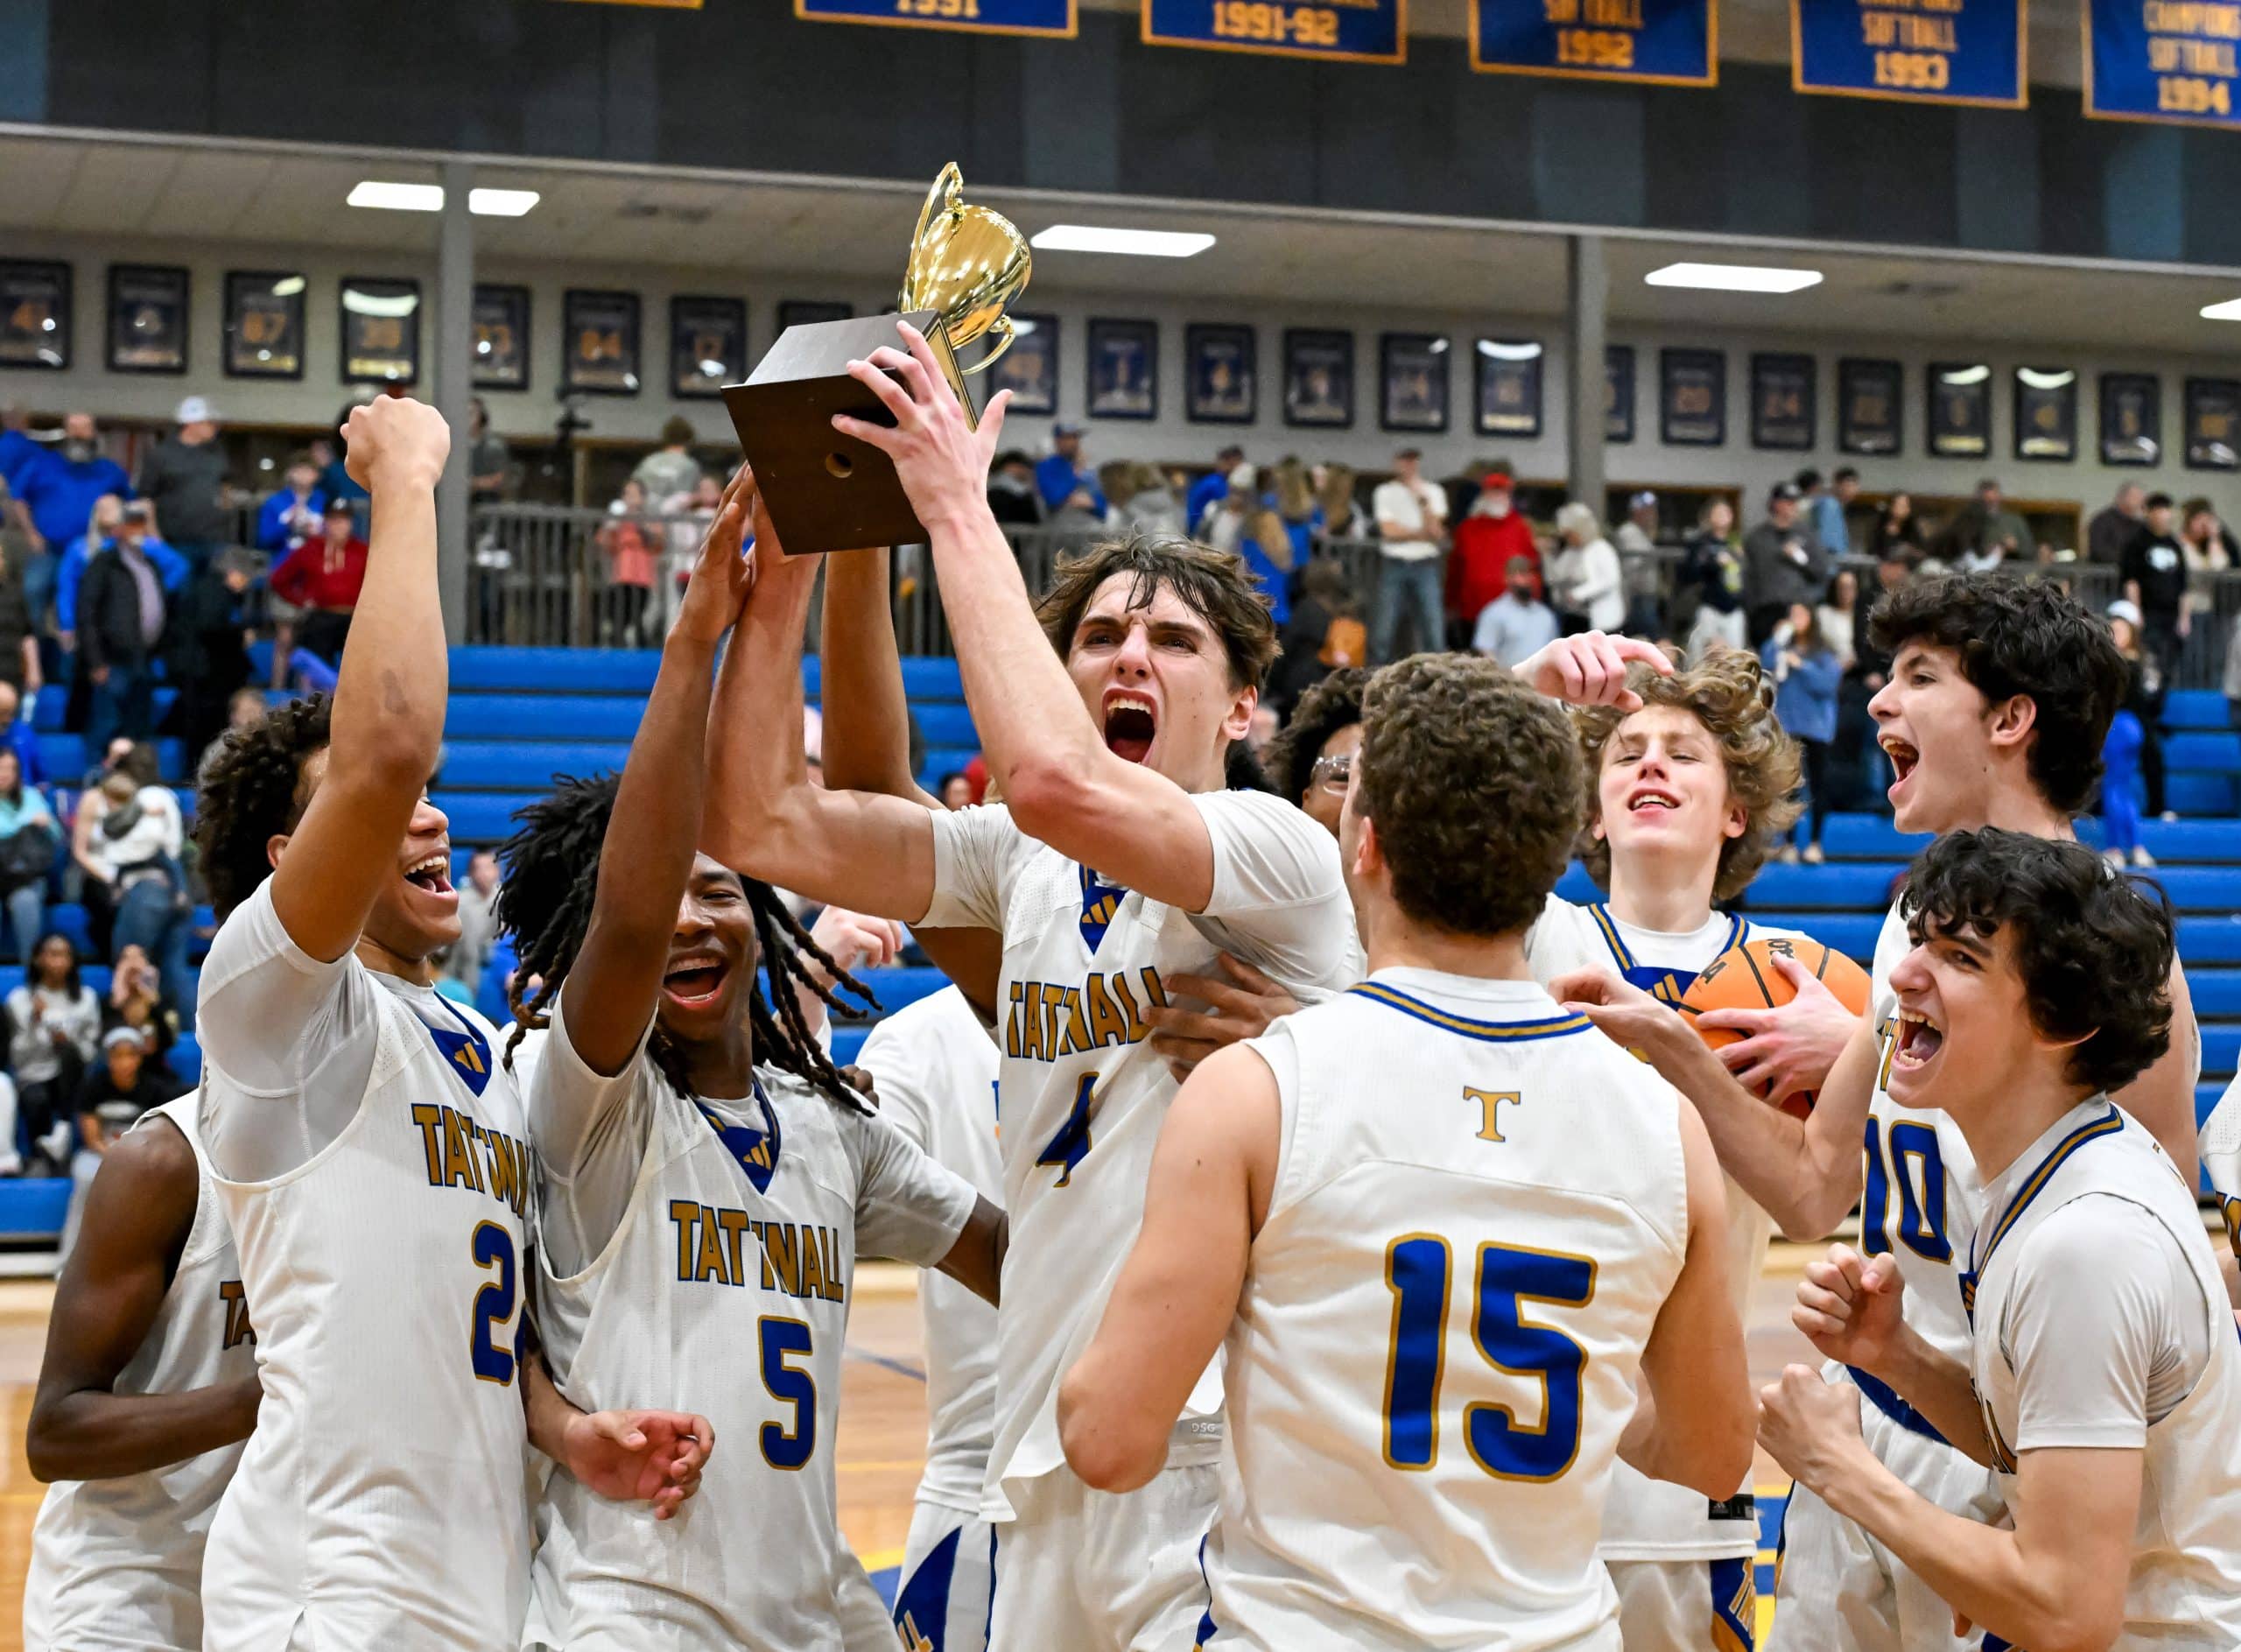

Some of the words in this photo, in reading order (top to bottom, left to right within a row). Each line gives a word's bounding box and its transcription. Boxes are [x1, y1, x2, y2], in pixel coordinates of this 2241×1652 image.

[1213, 1, 1338, 46] 1991-92
[1557, 30, 1633, 68] 1992
[1463, 1086, 1521, 1142] T
[1382, 1231, 1598, 1484] 15
[758, 1314, 816, 1472] 5
[1191, 1422, 1216, 1433] DSG
